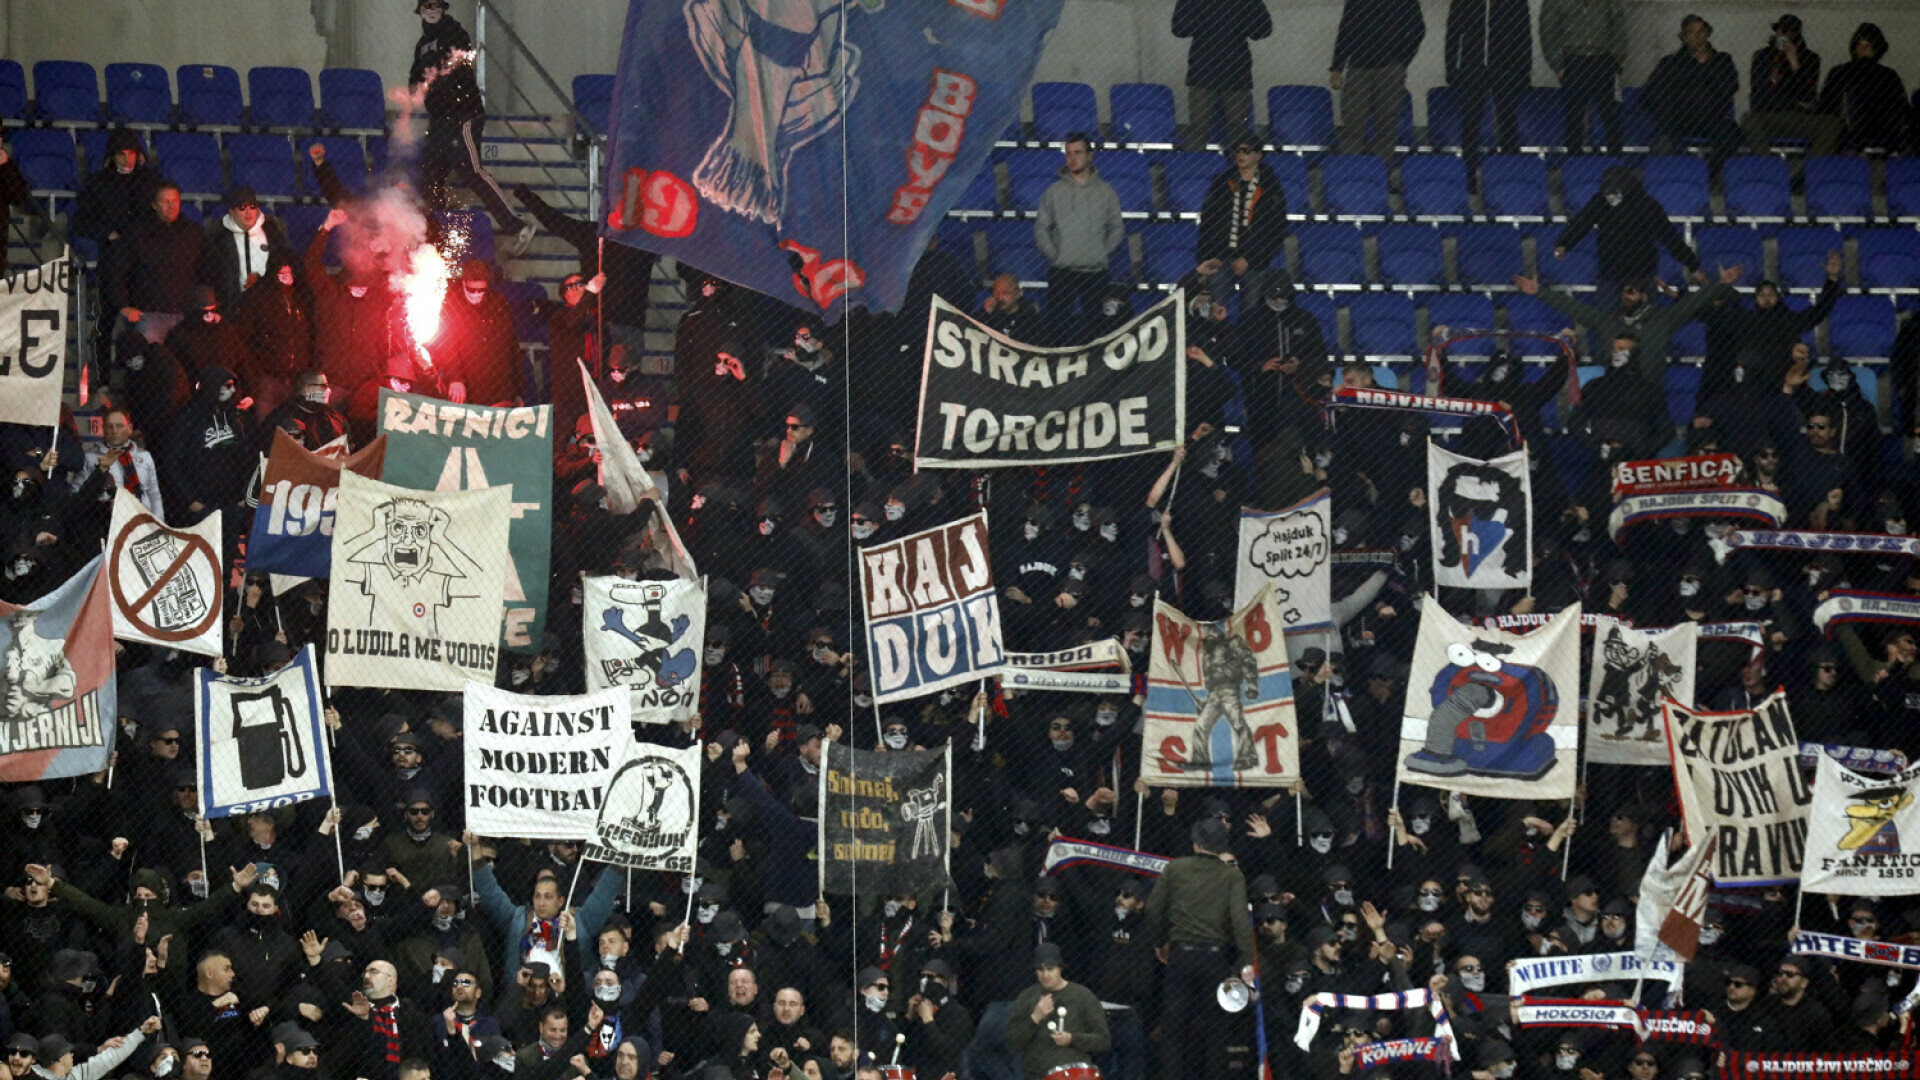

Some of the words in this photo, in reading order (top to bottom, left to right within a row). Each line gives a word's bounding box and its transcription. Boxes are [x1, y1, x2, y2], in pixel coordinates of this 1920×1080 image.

[608, 167, 699, 238] 19
[934, 320, 1090, 388] STRAH
[1103, 315, 1168, 370] OD
[1356, 391, 1493, 414] NAJVJERNIJI
[384, 397, 549, 439] RATNICI
[940, 396, 1149, 453] TORCIDE
[1619, 459, 1734, 485] BENFICA
[1640, 494, 1695, 509] HAJDUK
[1700, 493, 1741, 506] SPLIT
[1272, 525, 1314, 545] Hajduk
[1266, 548, 1293, 565] Split
[1295, 542, 1323, 560] 24/7
[865, 522, 989, 616] HAJ
[872, 595, 1003, 691] DUK
[1156, 612, 1192, 667] W
[1244, 602, 1272, 653] B
[343, 629, 411, 658] LUDILA
[415, 637, 441, 661] ME
[445, 641, 495, 671] VODIŠ
[1003, 647, 1092, 665] RCIDA
[479, 705, 614, 737] AGAINST
[479, 746, 612, 775] MODERN
[1253, 722, 1288, 774] T
[229, 792, 315, 815] SHOP
[1718, 818, 1808, 877] RAVU
[1879, 868, 1914, 878] 1950
[1795, 932, 1862, 958] HITE
[1516, 957, 1583, 983] WHITE
[1362, 1041, 1436, 1064] KONAVLE
[1762, 1060, 1814, 1073] HAJDUK
[1816, 1058, 1842, 1073] ŽIVI
[1843, 1057, 1893, 1073] VJEČNO
